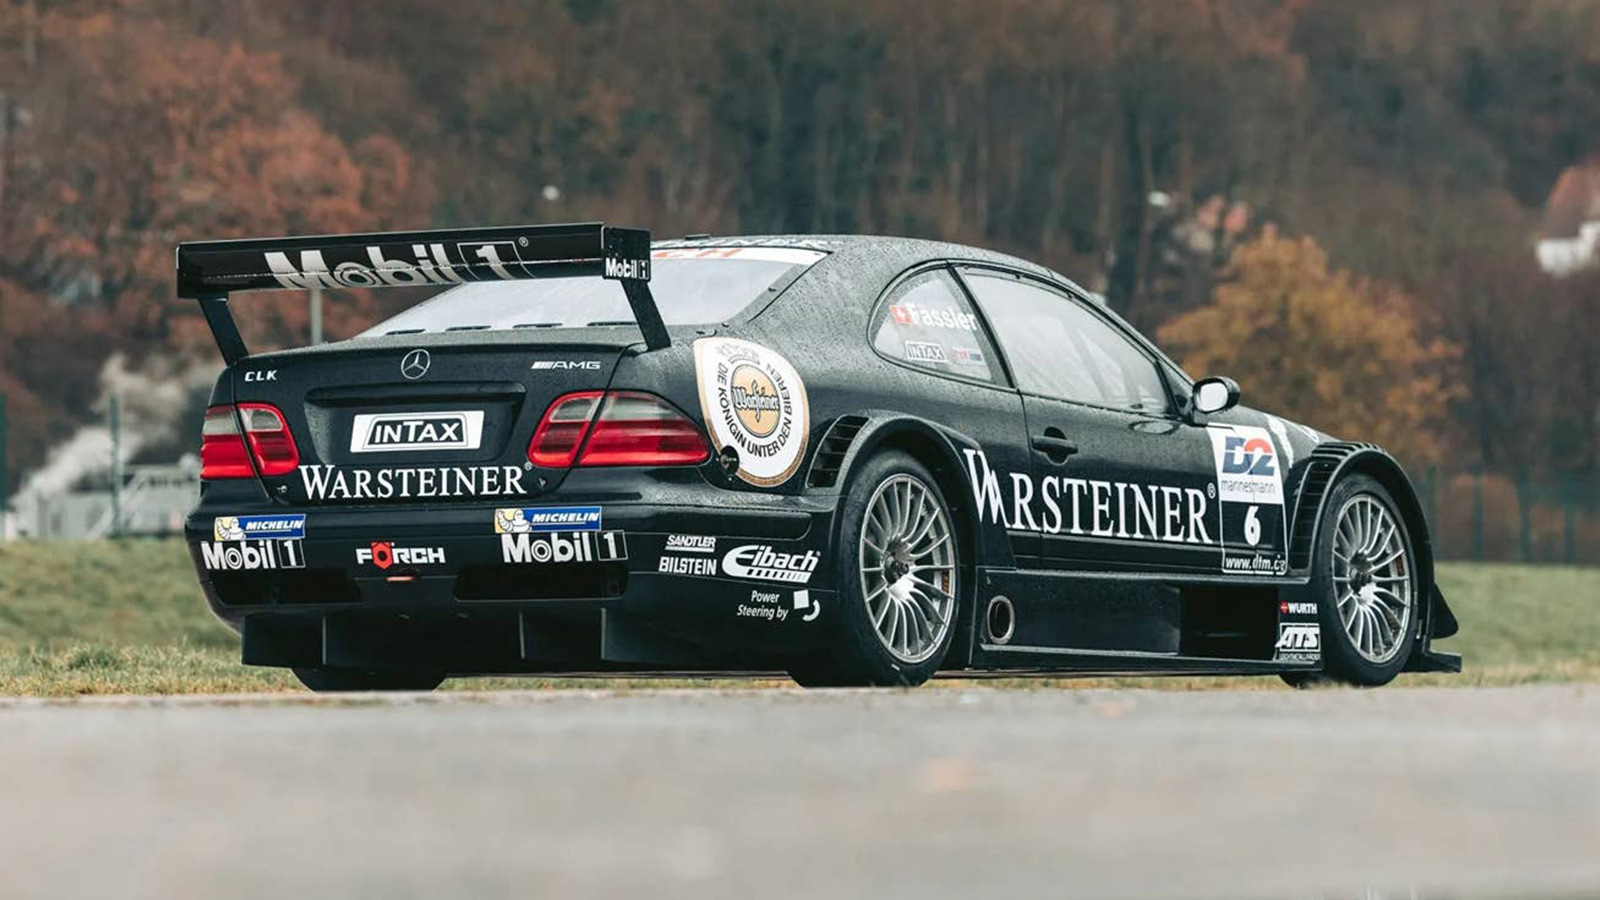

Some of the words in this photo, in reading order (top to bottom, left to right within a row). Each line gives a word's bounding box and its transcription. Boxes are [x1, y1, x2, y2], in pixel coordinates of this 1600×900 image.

[264, 243, 466, 288] Mobil
[475, 245, 518, 280] 1
[605, 257, 637, 278] Mobil
[244, 369, 278, 382] CLK
[717, 362, 728, 386] DIE
[766, 362, 793, 416] BIEREN
[777, 417, 792, 447] DEN
[747, 440, 780, 458] UNTER
[1222, 436, 1275, 477] D2
[299, 464, 527, 500] WARSTEINER
[1220, 479, 1276, 494] mannesmann
[963, 448, 1213, 545] WARSTEINER
[246, 518, 304, 531] MICHELIN
[531, 512, 599, 523] MICHELIN
[1243, 504, 1261, 547] 6
[501, 532, 593, 563] Mobil
[666, 535, 716, 548] SANDTLER
[201, 539, 275, 570] Mobil
[722, 545, 819, 583] Eibach
[658, 556, 717, 576] BILSTEIN
[751, 590, 780, 603] Power
[737, 604, 775, 620] Steering
[776, 606, 789, 621] by
[1275, 627, 1320, 648] ATS
